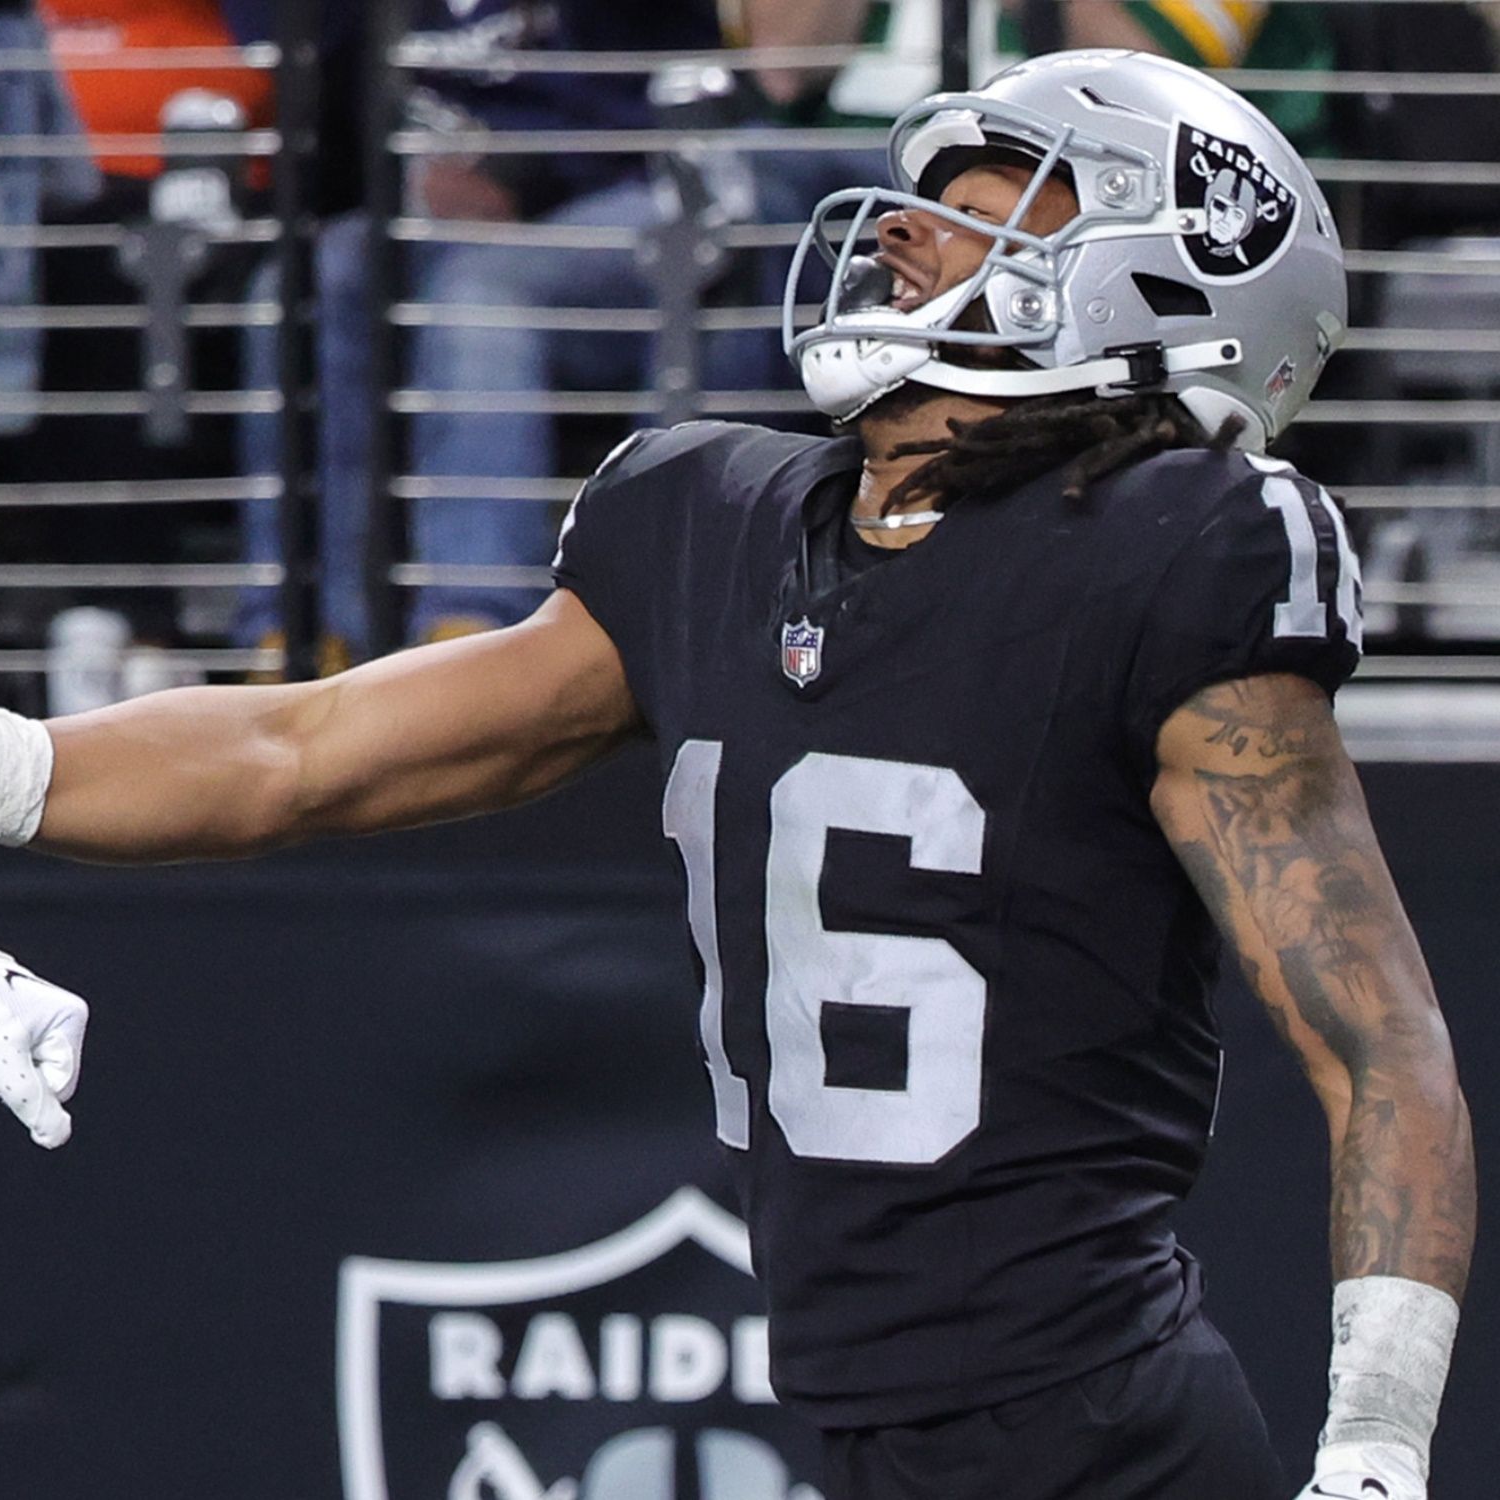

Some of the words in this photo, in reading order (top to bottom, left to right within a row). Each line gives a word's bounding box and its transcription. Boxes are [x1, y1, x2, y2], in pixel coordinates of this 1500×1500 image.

[1190, 130, 1288, 202] RAIDERS
[787, 648, 815, 673] NFL
[663, 739, 986, 1163] 16
